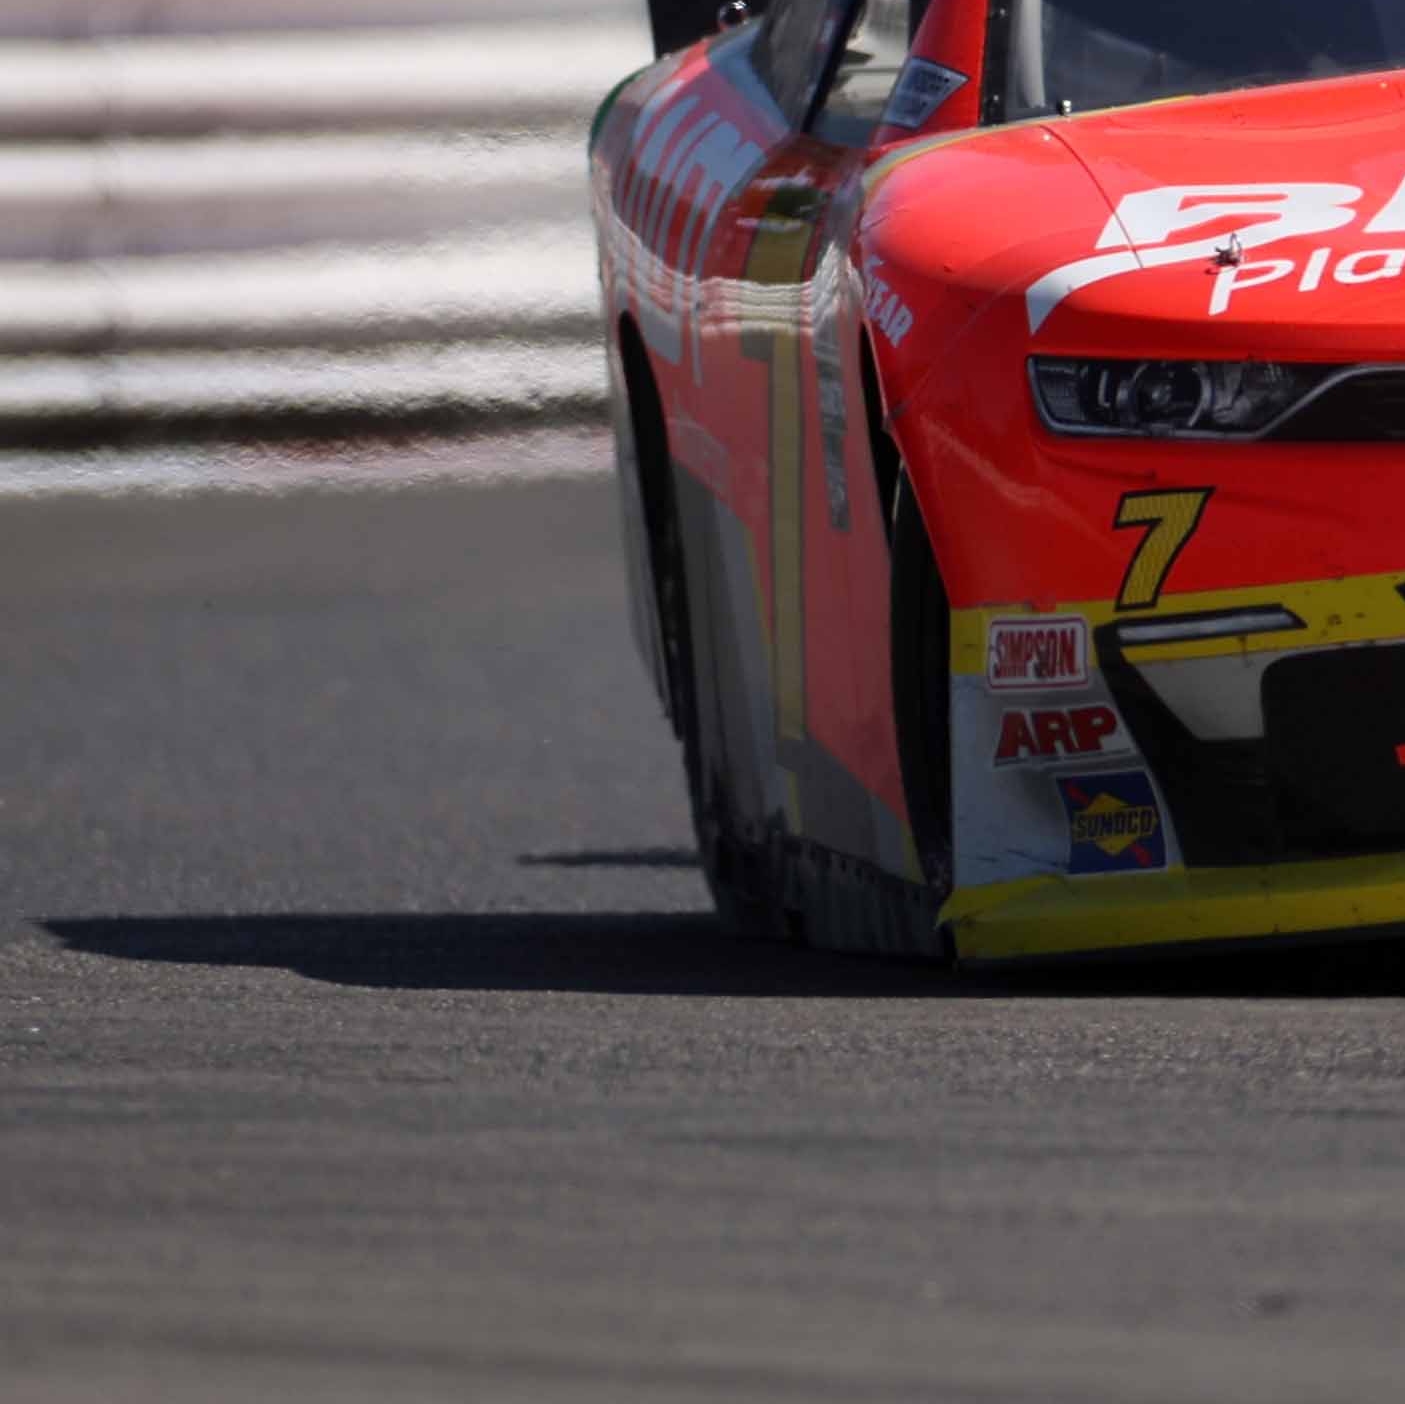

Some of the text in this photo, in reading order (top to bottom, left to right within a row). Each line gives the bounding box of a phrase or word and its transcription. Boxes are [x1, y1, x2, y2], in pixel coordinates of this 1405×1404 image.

[1112, 485, 1216, 613] 7
[993, 627, 1079, 681] SIMPSON
[994, 705, 1118, 760] ARP
[1073, 807, 1157, 841] SUNOCO
